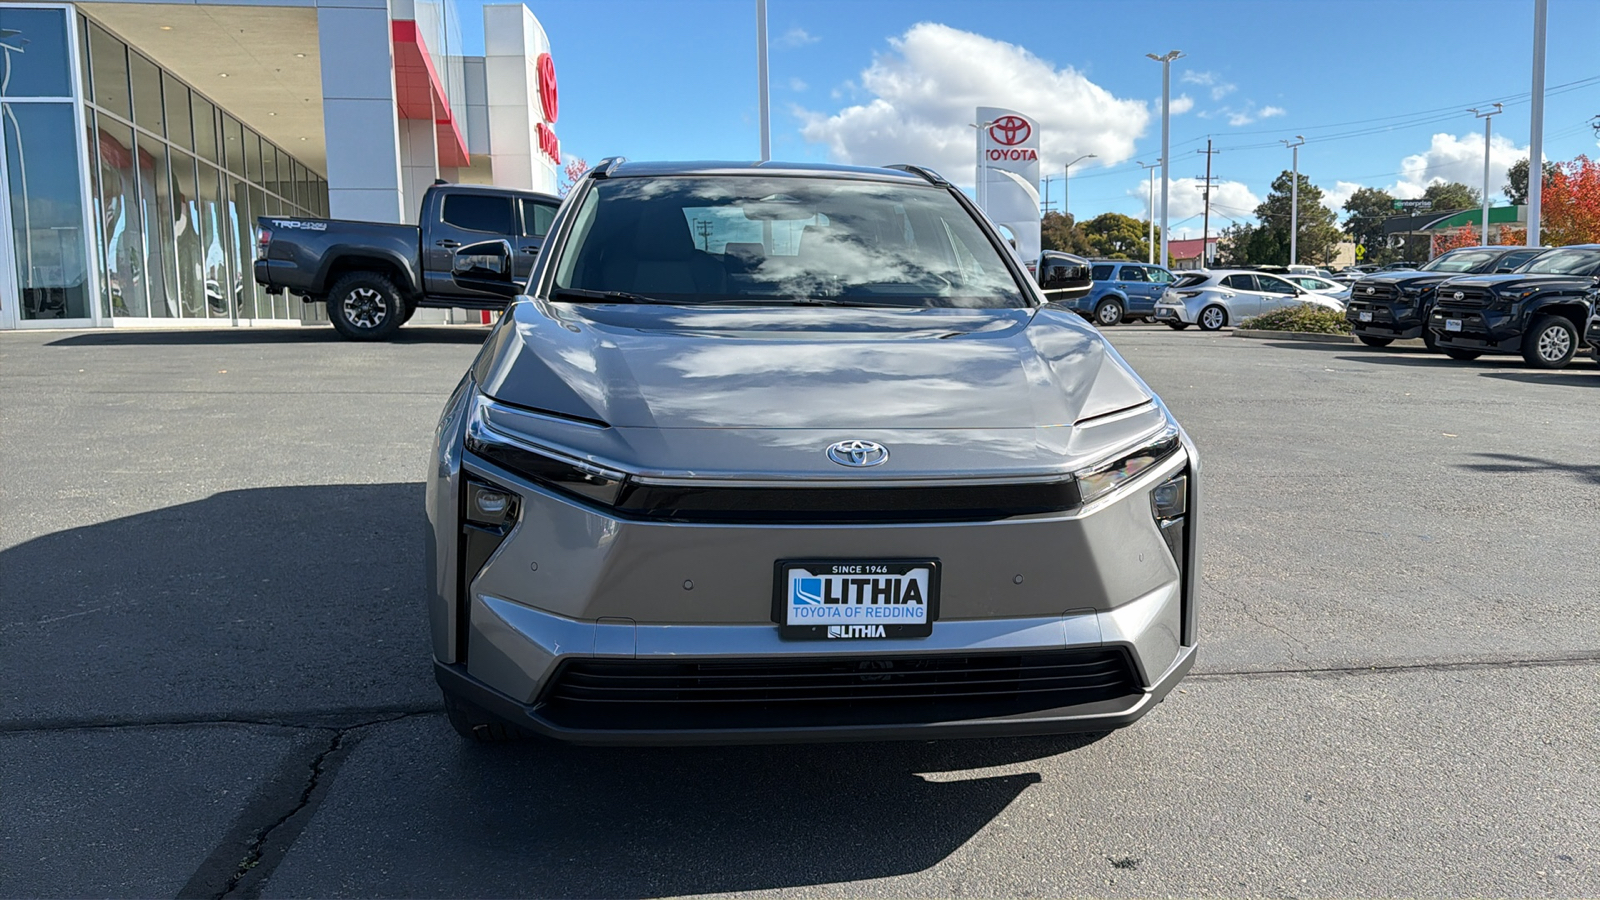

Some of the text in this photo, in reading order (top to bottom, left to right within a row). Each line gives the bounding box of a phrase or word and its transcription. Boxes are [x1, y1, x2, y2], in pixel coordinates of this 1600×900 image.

[271, 220, 301, 229] TRD
[832, 565, 888, 574] SINCE 1946
[823, 578, 924, 605] LITHIA
[793, 606, 924, 618] TOYOTA OF REDDING
[841, 625, 886, 638] LITHIA
